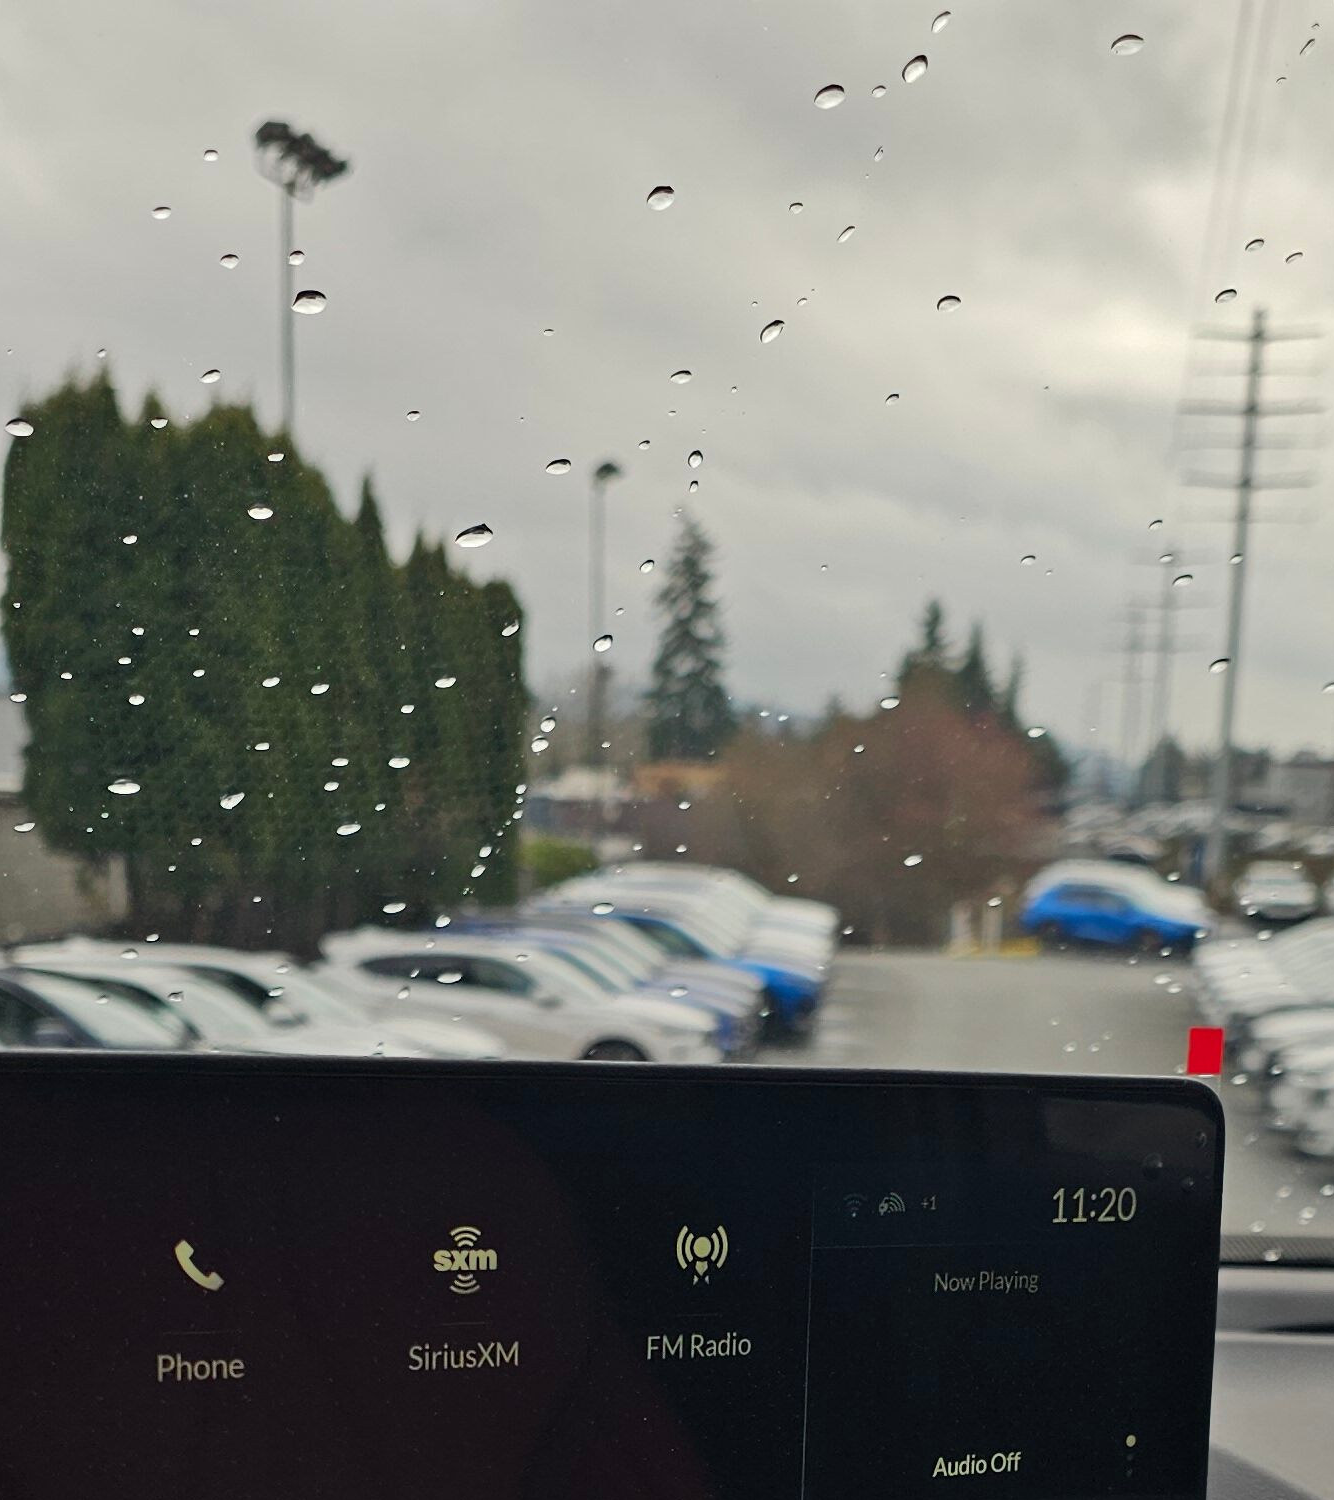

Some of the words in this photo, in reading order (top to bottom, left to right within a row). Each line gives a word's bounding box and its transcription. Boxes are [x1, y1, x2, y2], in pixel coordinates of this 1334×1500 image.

[1051, 1187, 1136, 1223] 11:20
[934, 1270, 975, 1292] Now
[979, 1269, 1038, 1294] Playing
[408, 1341, 520, 1371] SiriusXM
[646, 1335, 685, 1360] FM
[691, 1332, 751, 1359] Radio
[157, 1352, 245, 1383] Phone
[932, 1453, 987, 1476] Audio
[991, 1452, 1021, 1474] Off
